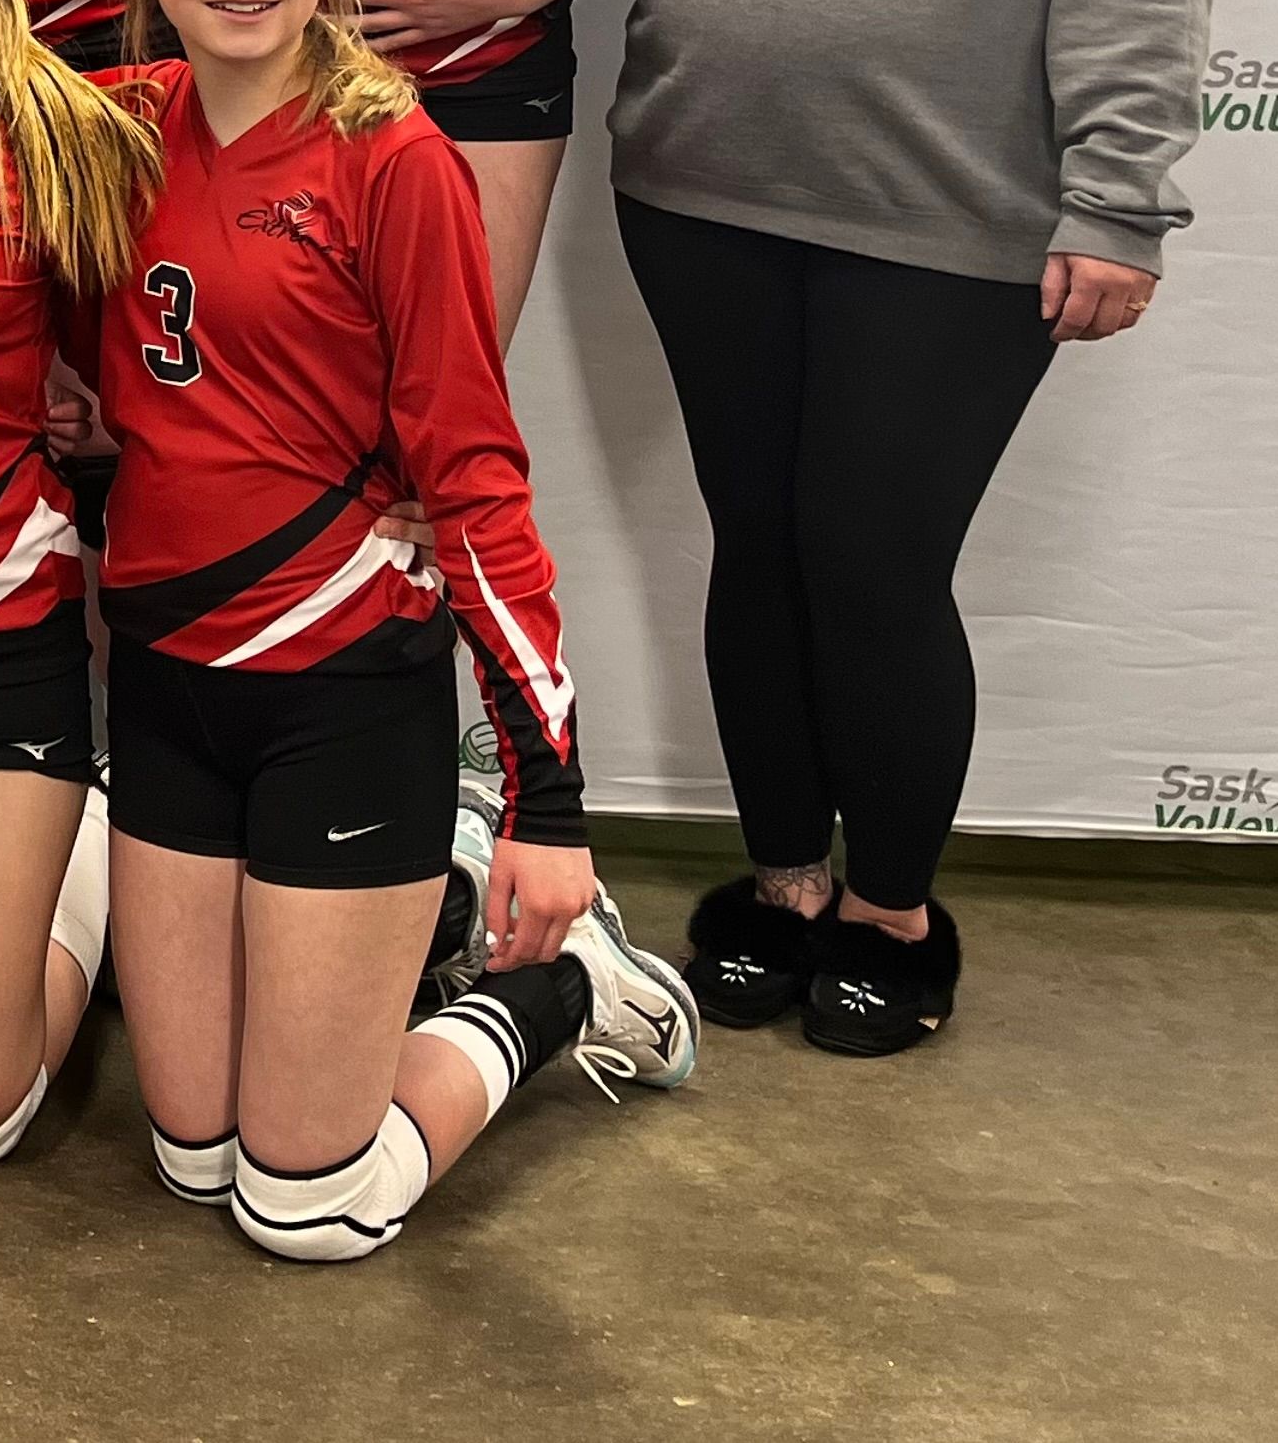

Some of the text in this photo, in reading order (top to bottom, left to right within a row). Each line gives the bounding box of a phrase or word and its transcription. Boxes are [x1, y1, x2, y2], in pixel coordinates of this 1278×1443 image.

[1202, 50, 1278, 89] Sas
[141, 260, 203, 388] 3
[1157, 765, 1272, 804] Sask
